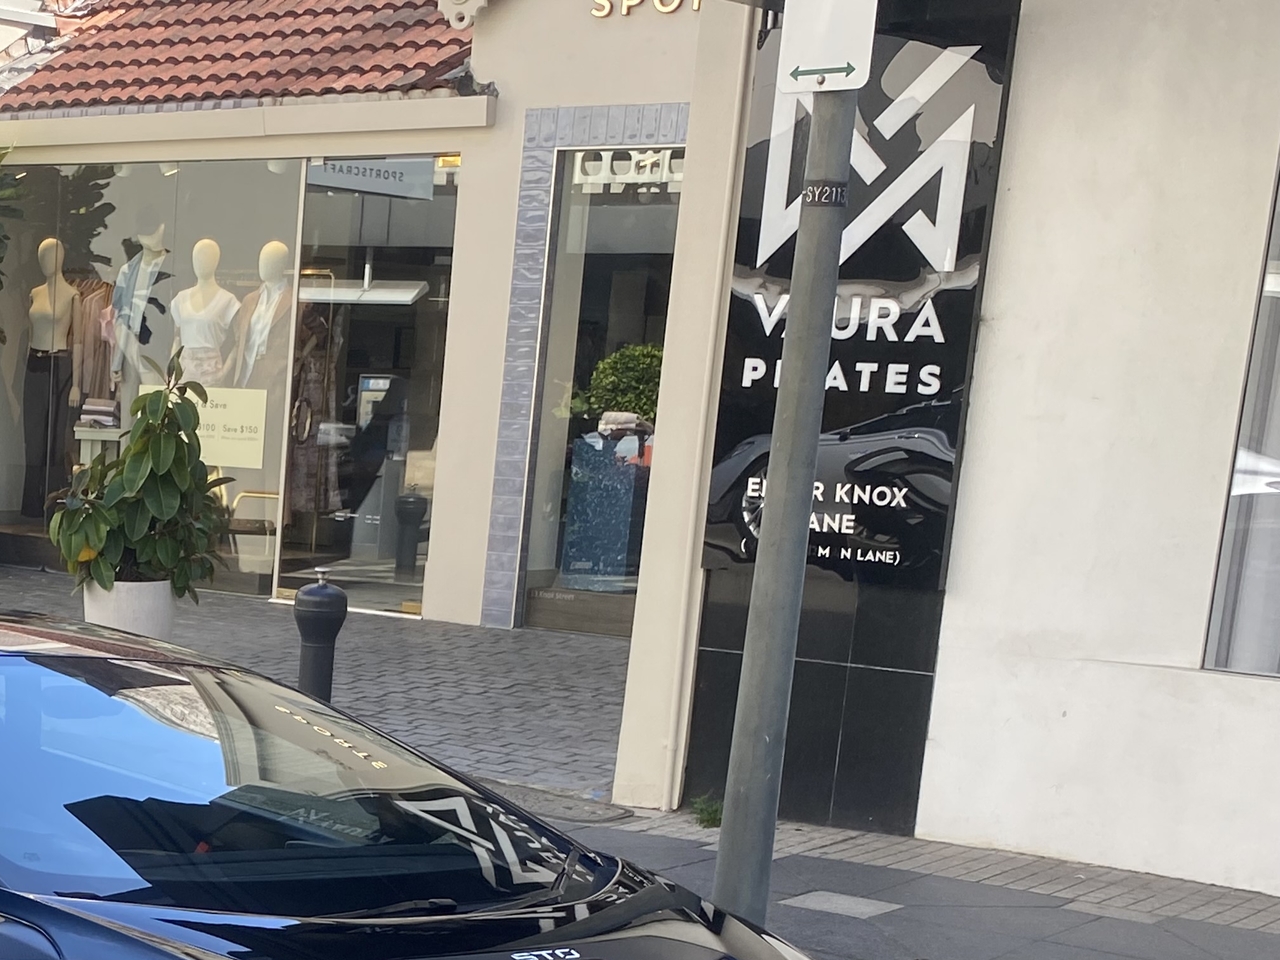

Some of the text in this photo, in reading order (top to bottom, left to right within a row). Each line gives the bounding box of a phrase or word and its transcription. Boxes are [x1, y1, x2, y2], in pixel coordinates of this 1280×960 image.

[753, 293, 946, 343] VURA
[741, 357, 942, 396] PIATES
[209, 400, 227, 410] Save
[222, 424, 238, 433] Save
[239, 425, 259, 434] $150
[835, 482, 909, 508] KNOX
[809, 511, 856, 534] ANE
[856, 549, 901, 566] LANE)
